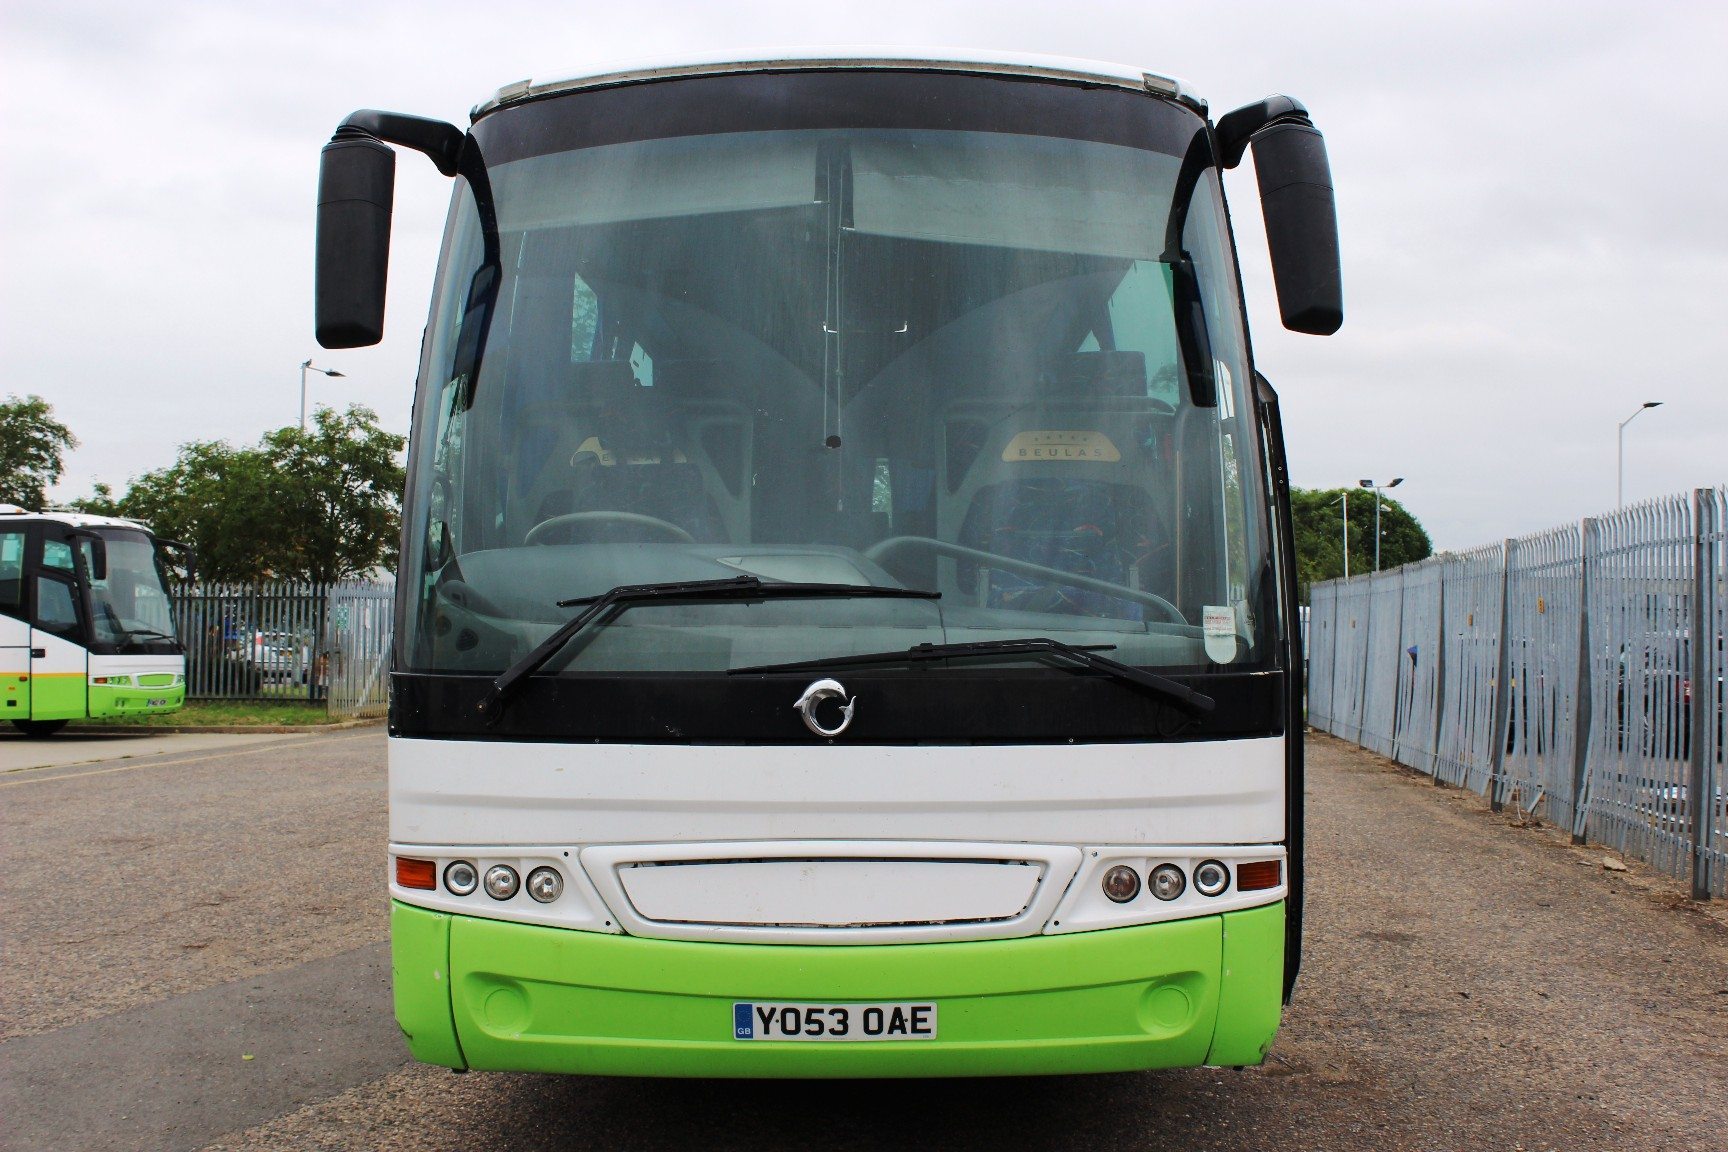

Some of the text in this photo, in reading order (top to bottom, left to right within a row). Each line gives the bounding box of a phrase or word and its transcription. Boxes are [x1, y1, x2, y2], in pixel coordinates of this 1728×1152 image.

[1018, 448, 1103, 457] BEULAS
[756, 1006, 932, 1036] YO53 OAE
[737, 1027, 752, 1036] GB
